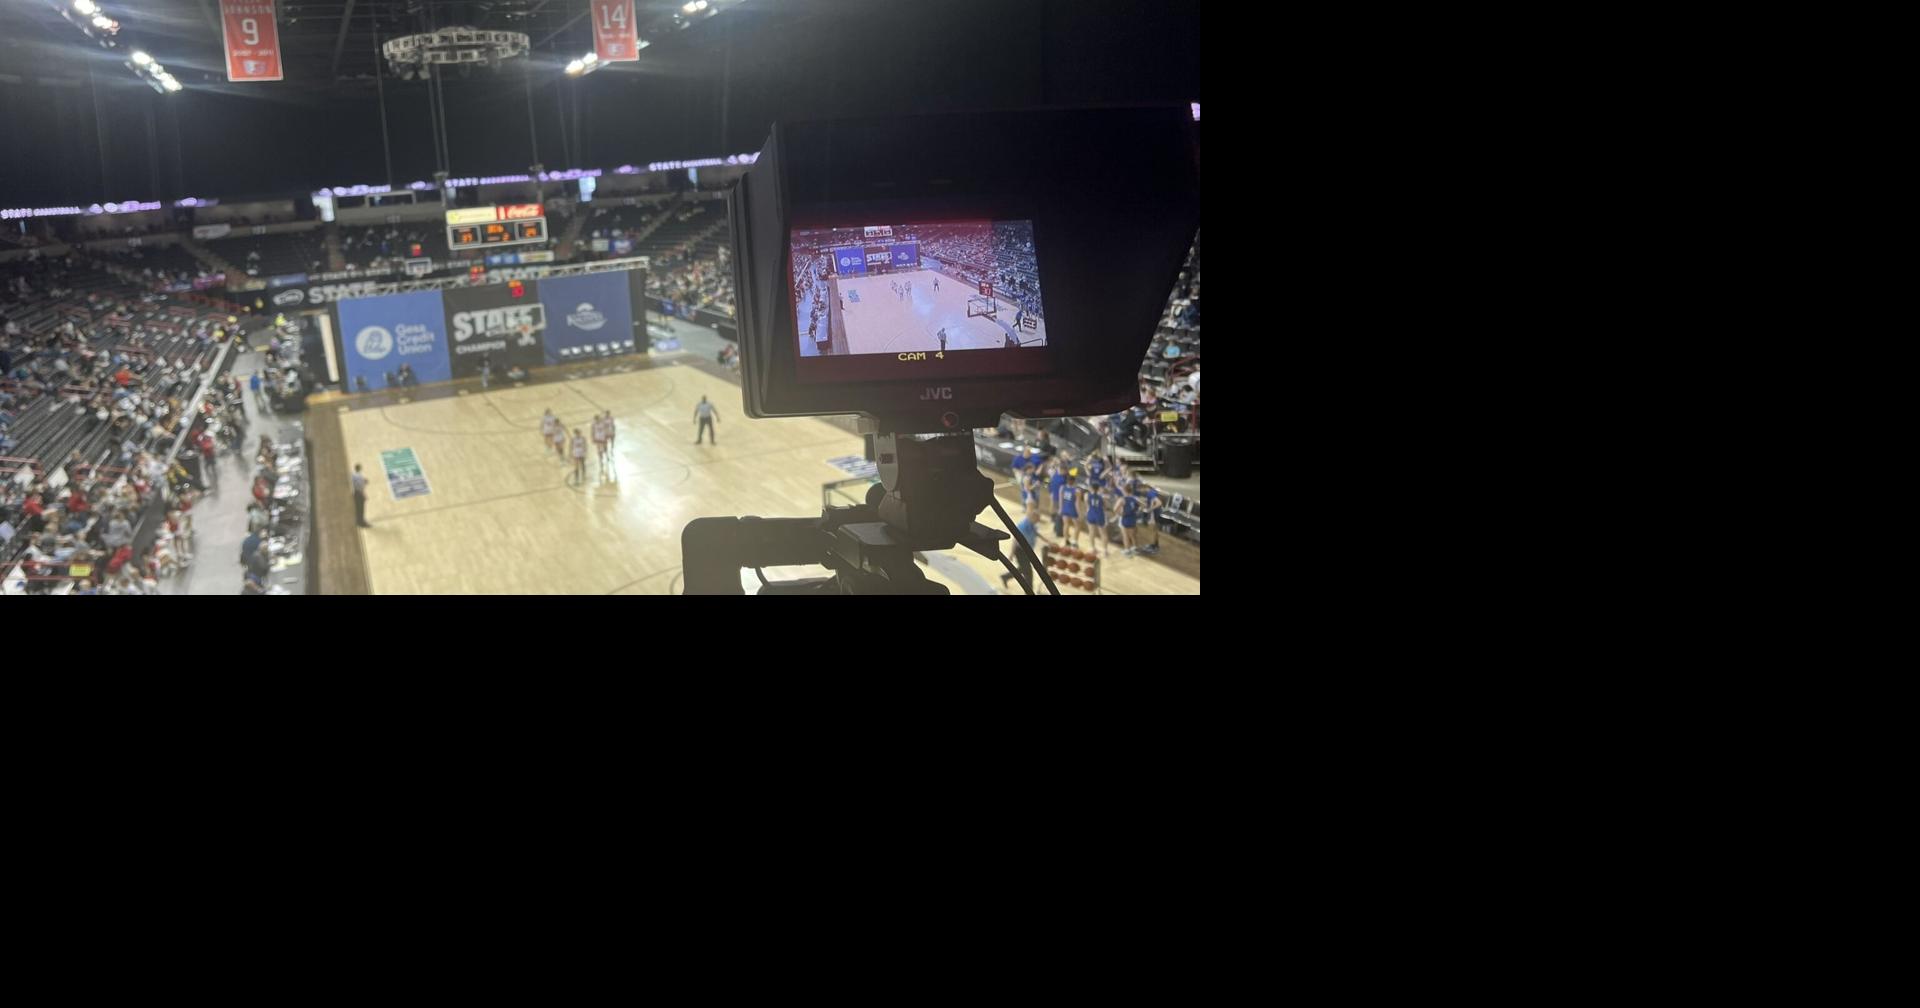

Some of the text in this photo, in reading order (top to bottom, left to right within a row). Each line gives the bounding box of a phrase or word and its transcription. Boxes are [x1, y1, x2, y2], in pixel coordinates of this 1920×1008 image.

[602, 4, 626, 29] 14
[241, 18, 259, 45] 9
[649, 160, 681, 171] STATE
[445, 177, 478, 188] STATE
[397, 332, 435, 345] Credit
[398, 344, 432, 356] Union
[898, 351, 945, 361] CAM 4
[920, 387, 953, 401] JVC
